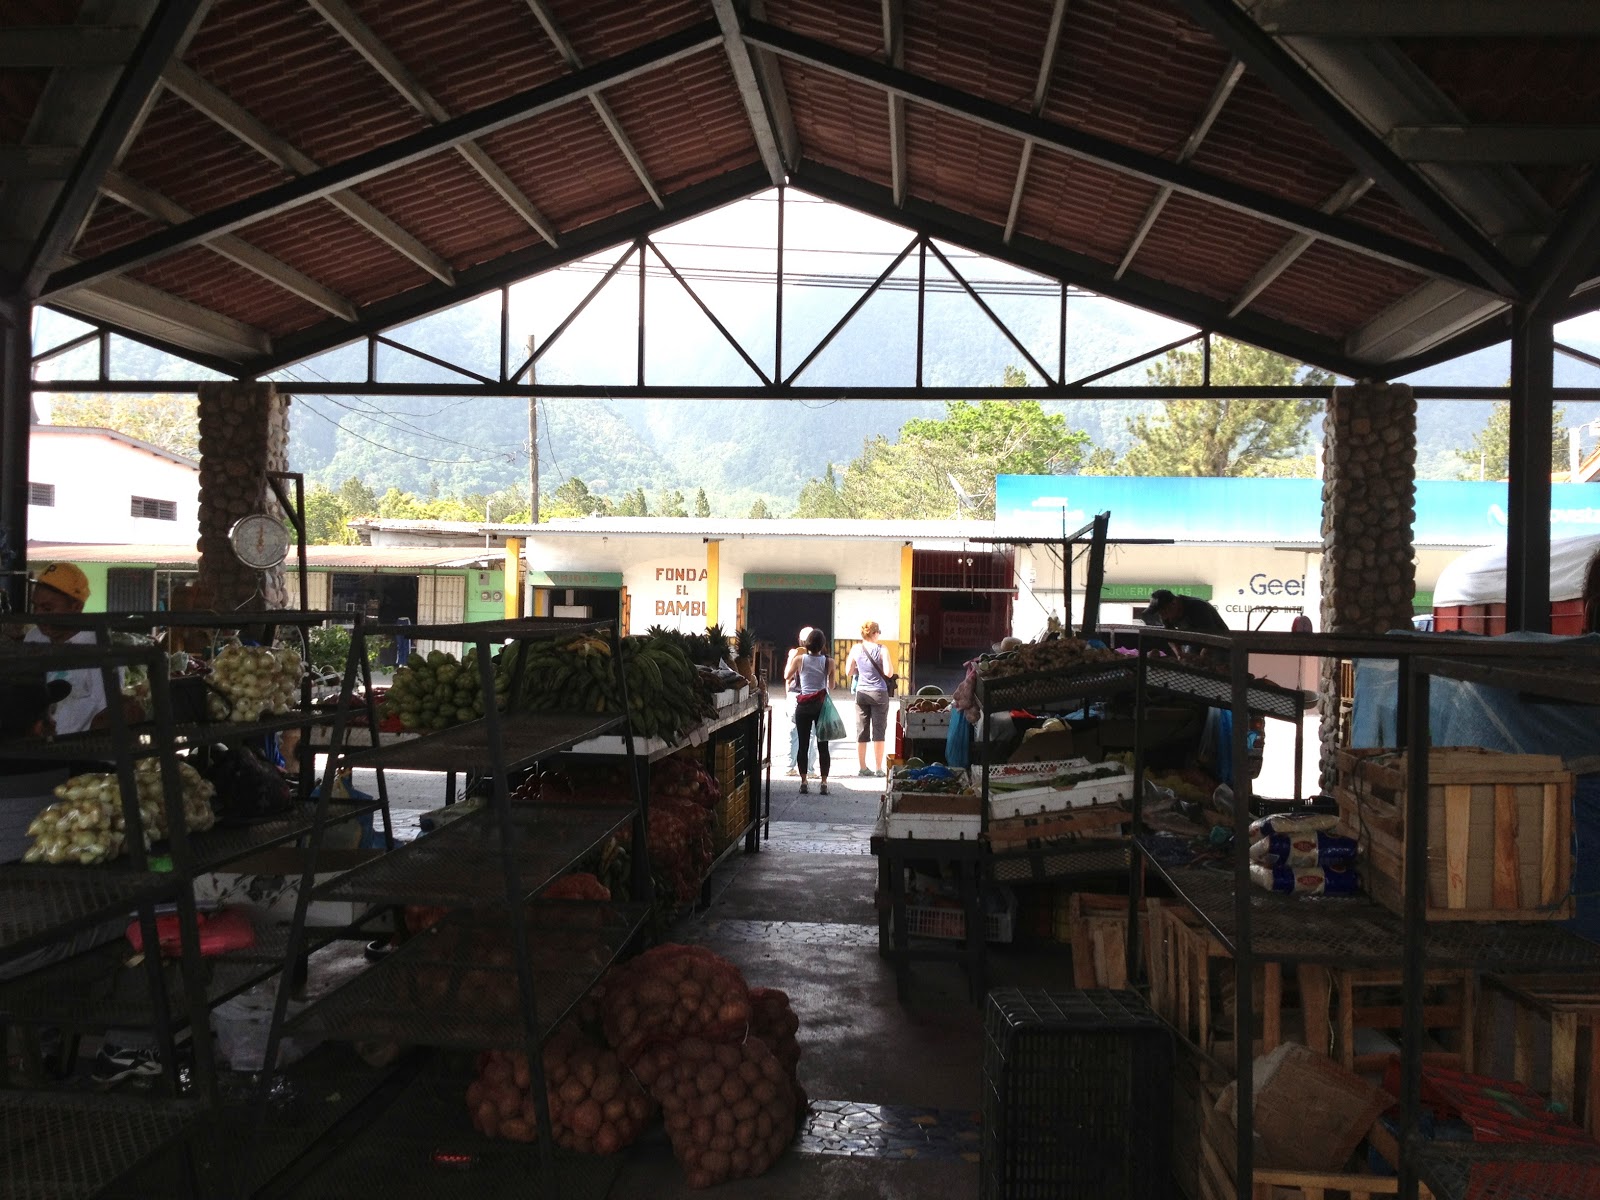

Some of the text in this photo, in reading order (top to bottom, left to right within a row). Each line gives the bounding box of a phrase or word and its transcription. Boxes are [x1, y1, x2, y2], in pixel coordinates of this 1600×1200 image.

[656, 568, 707, 581] FONDA
[676, 585, 689, 595] EL
[1108, 587, 1153, 596] JOYERIA
